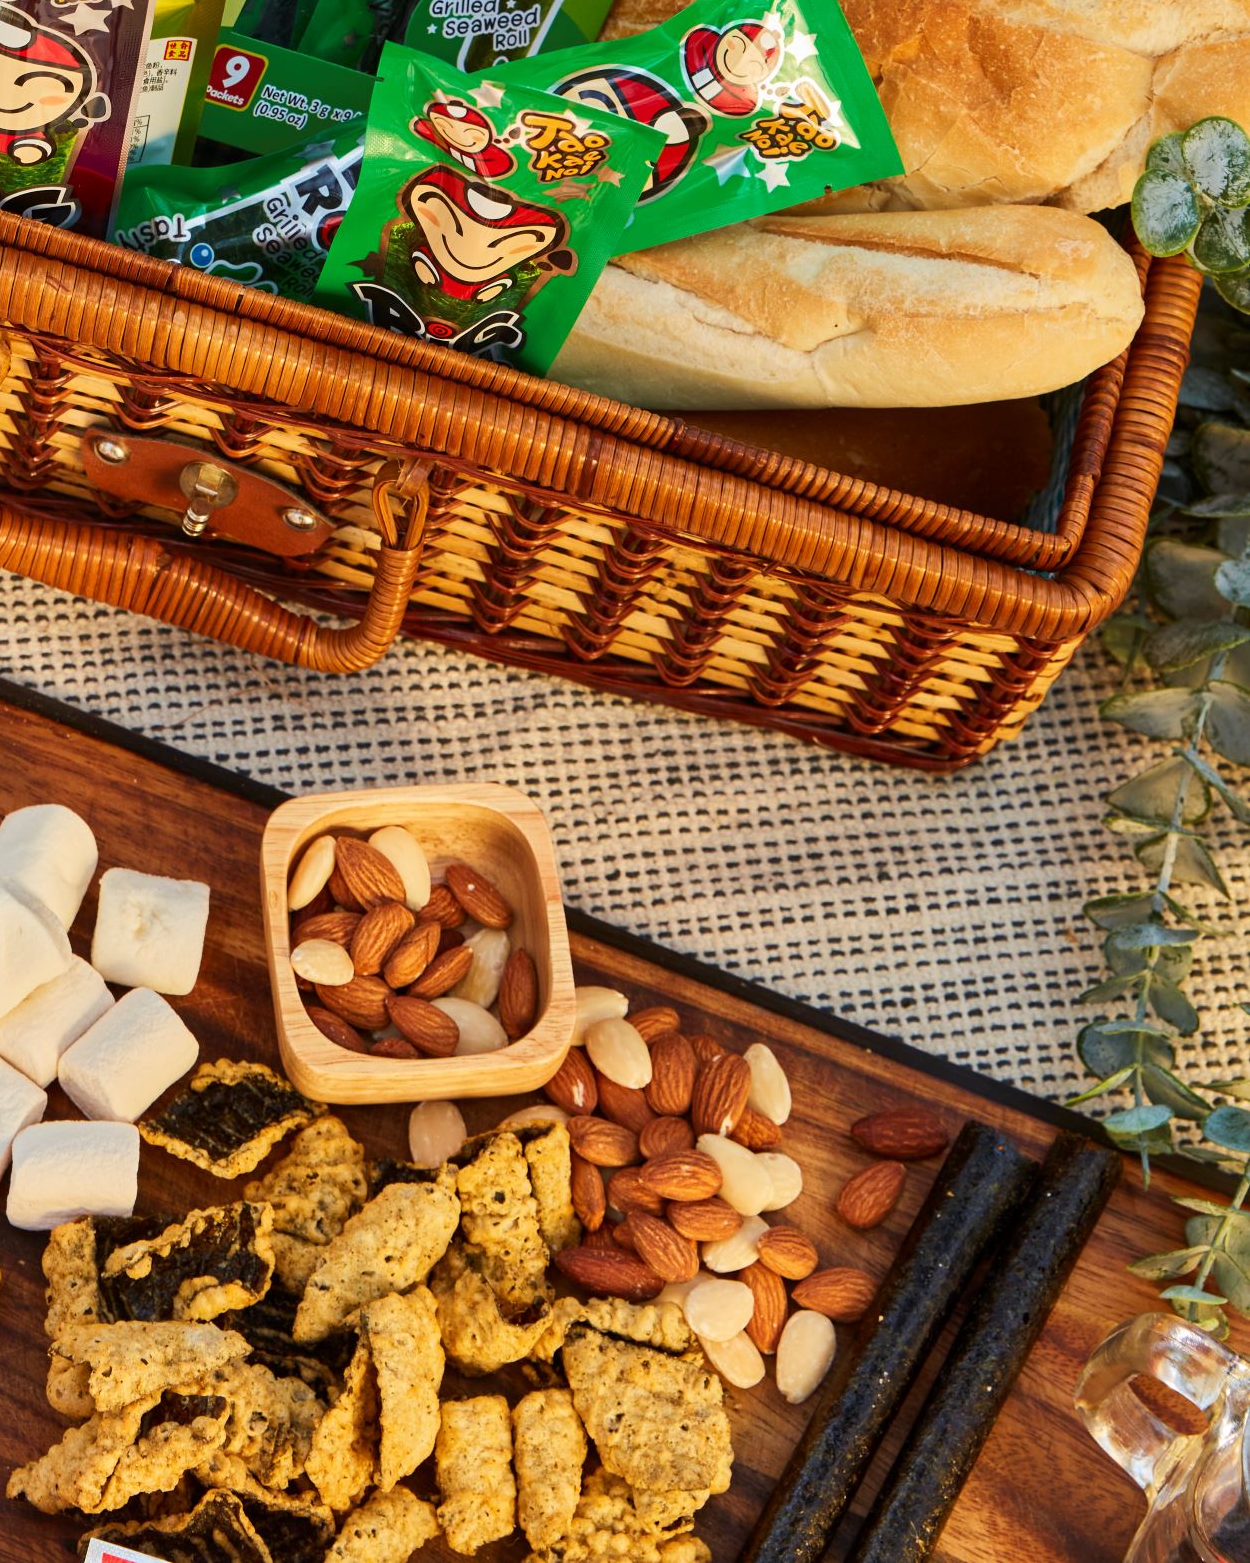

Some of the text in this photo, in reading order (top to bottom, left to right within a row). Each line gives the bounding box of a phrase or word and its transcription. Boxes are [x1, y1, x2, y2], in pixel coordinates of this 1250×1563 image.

[445, 7, 539, 36] Seaweed
[495, 32, 528, 51] Roll
[221, 55, 251, 89] 9
[262, 86, 286, 103] Net
[288, 93, 308, 110] Wt.
[254, 102, 307, 129] (0.95 oz)
[523, 113, 607, 151] Tao
[740, 129, 790, 157] Noi
[757, 118, 810, 155] Kae
[535, 149, 601, 173] Kae
[544, 161, 592, 182] Noi
[266, 196, 323, 260] Grilled
